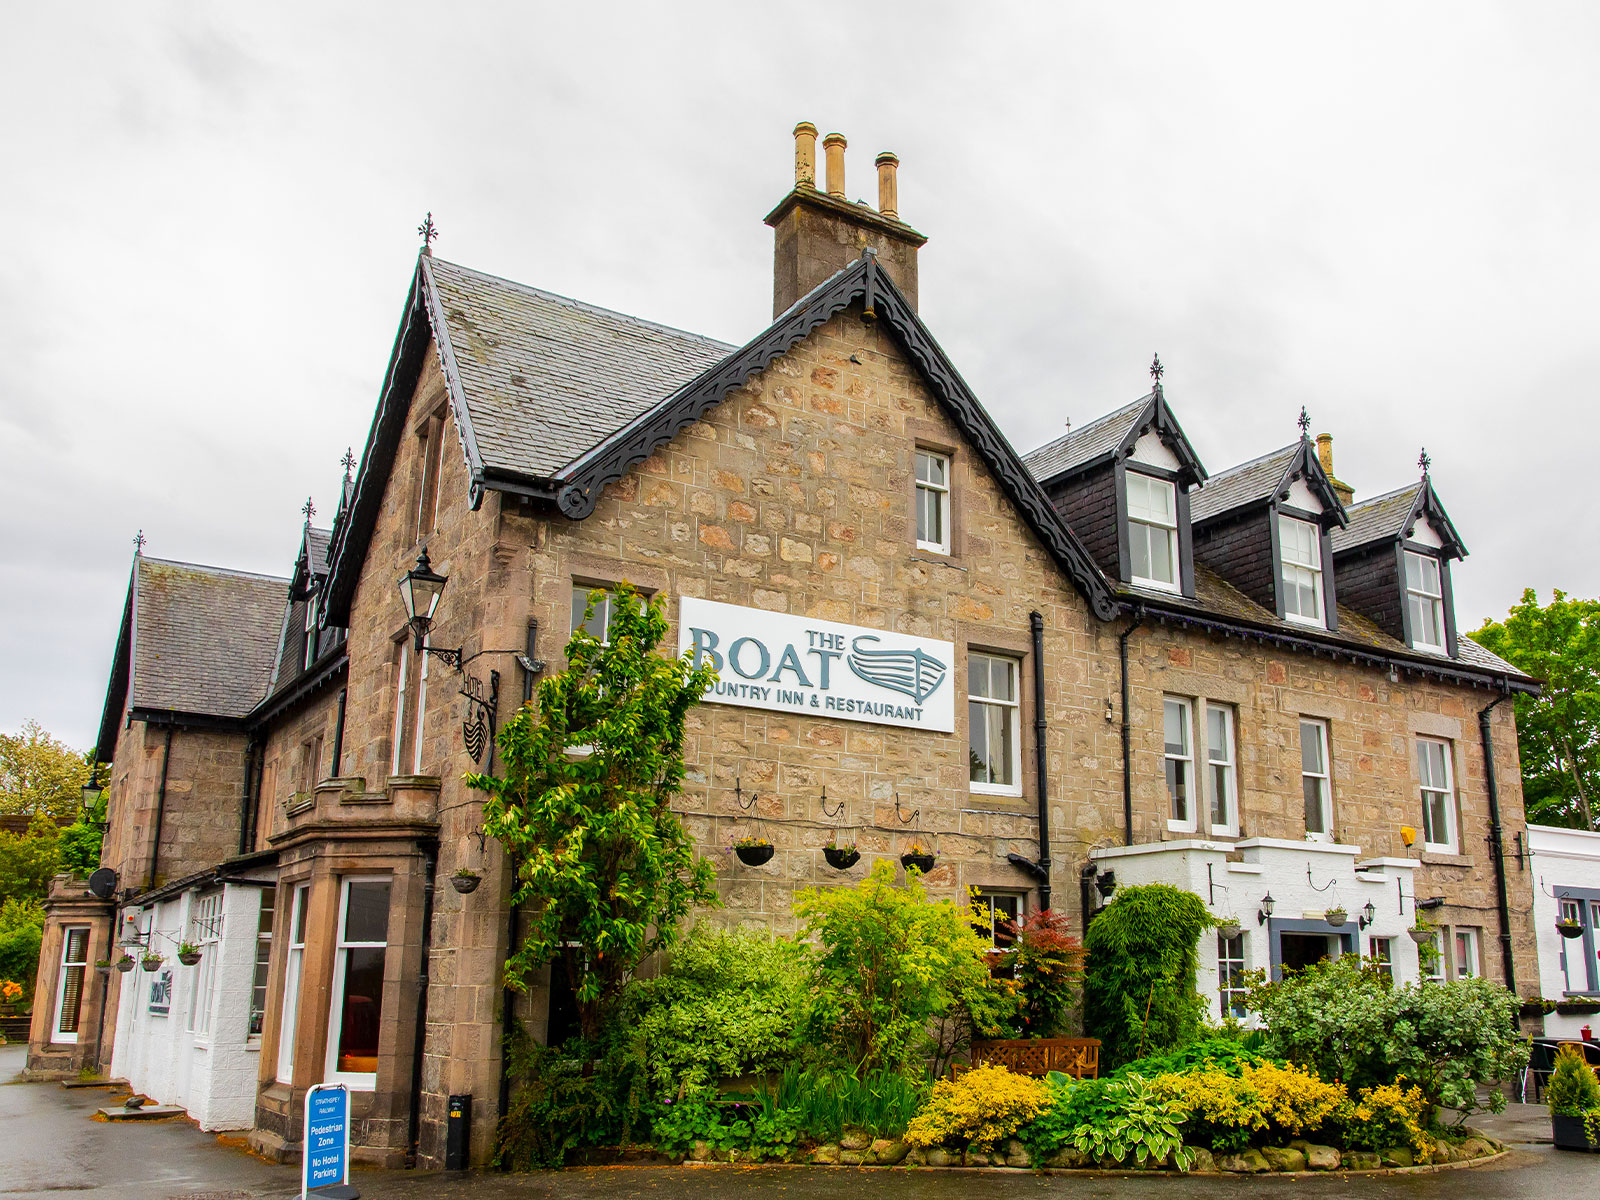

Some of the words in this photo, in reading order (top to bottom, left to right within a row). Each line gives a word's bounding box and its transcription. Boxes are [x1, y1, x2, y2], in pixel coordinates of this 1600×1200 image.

[805, 629, 846, 651] THE
[688, 627, 843, 690] BOAT
[704, 681, 771, 701] OUNTRY
[776, 688, 804, 706] INN
[810, 694, 820, 708] &
[825, 696, 924, 721] RESTAURANT
[311, 1123, 343, 1136] Pedestrian
[318, 1137, 334, 1146] Zone
[312, 1158, 321, 1167] No
[322, 1154, 339, 1165] Hotel
[313, 1168, 337, 1180] Parking
